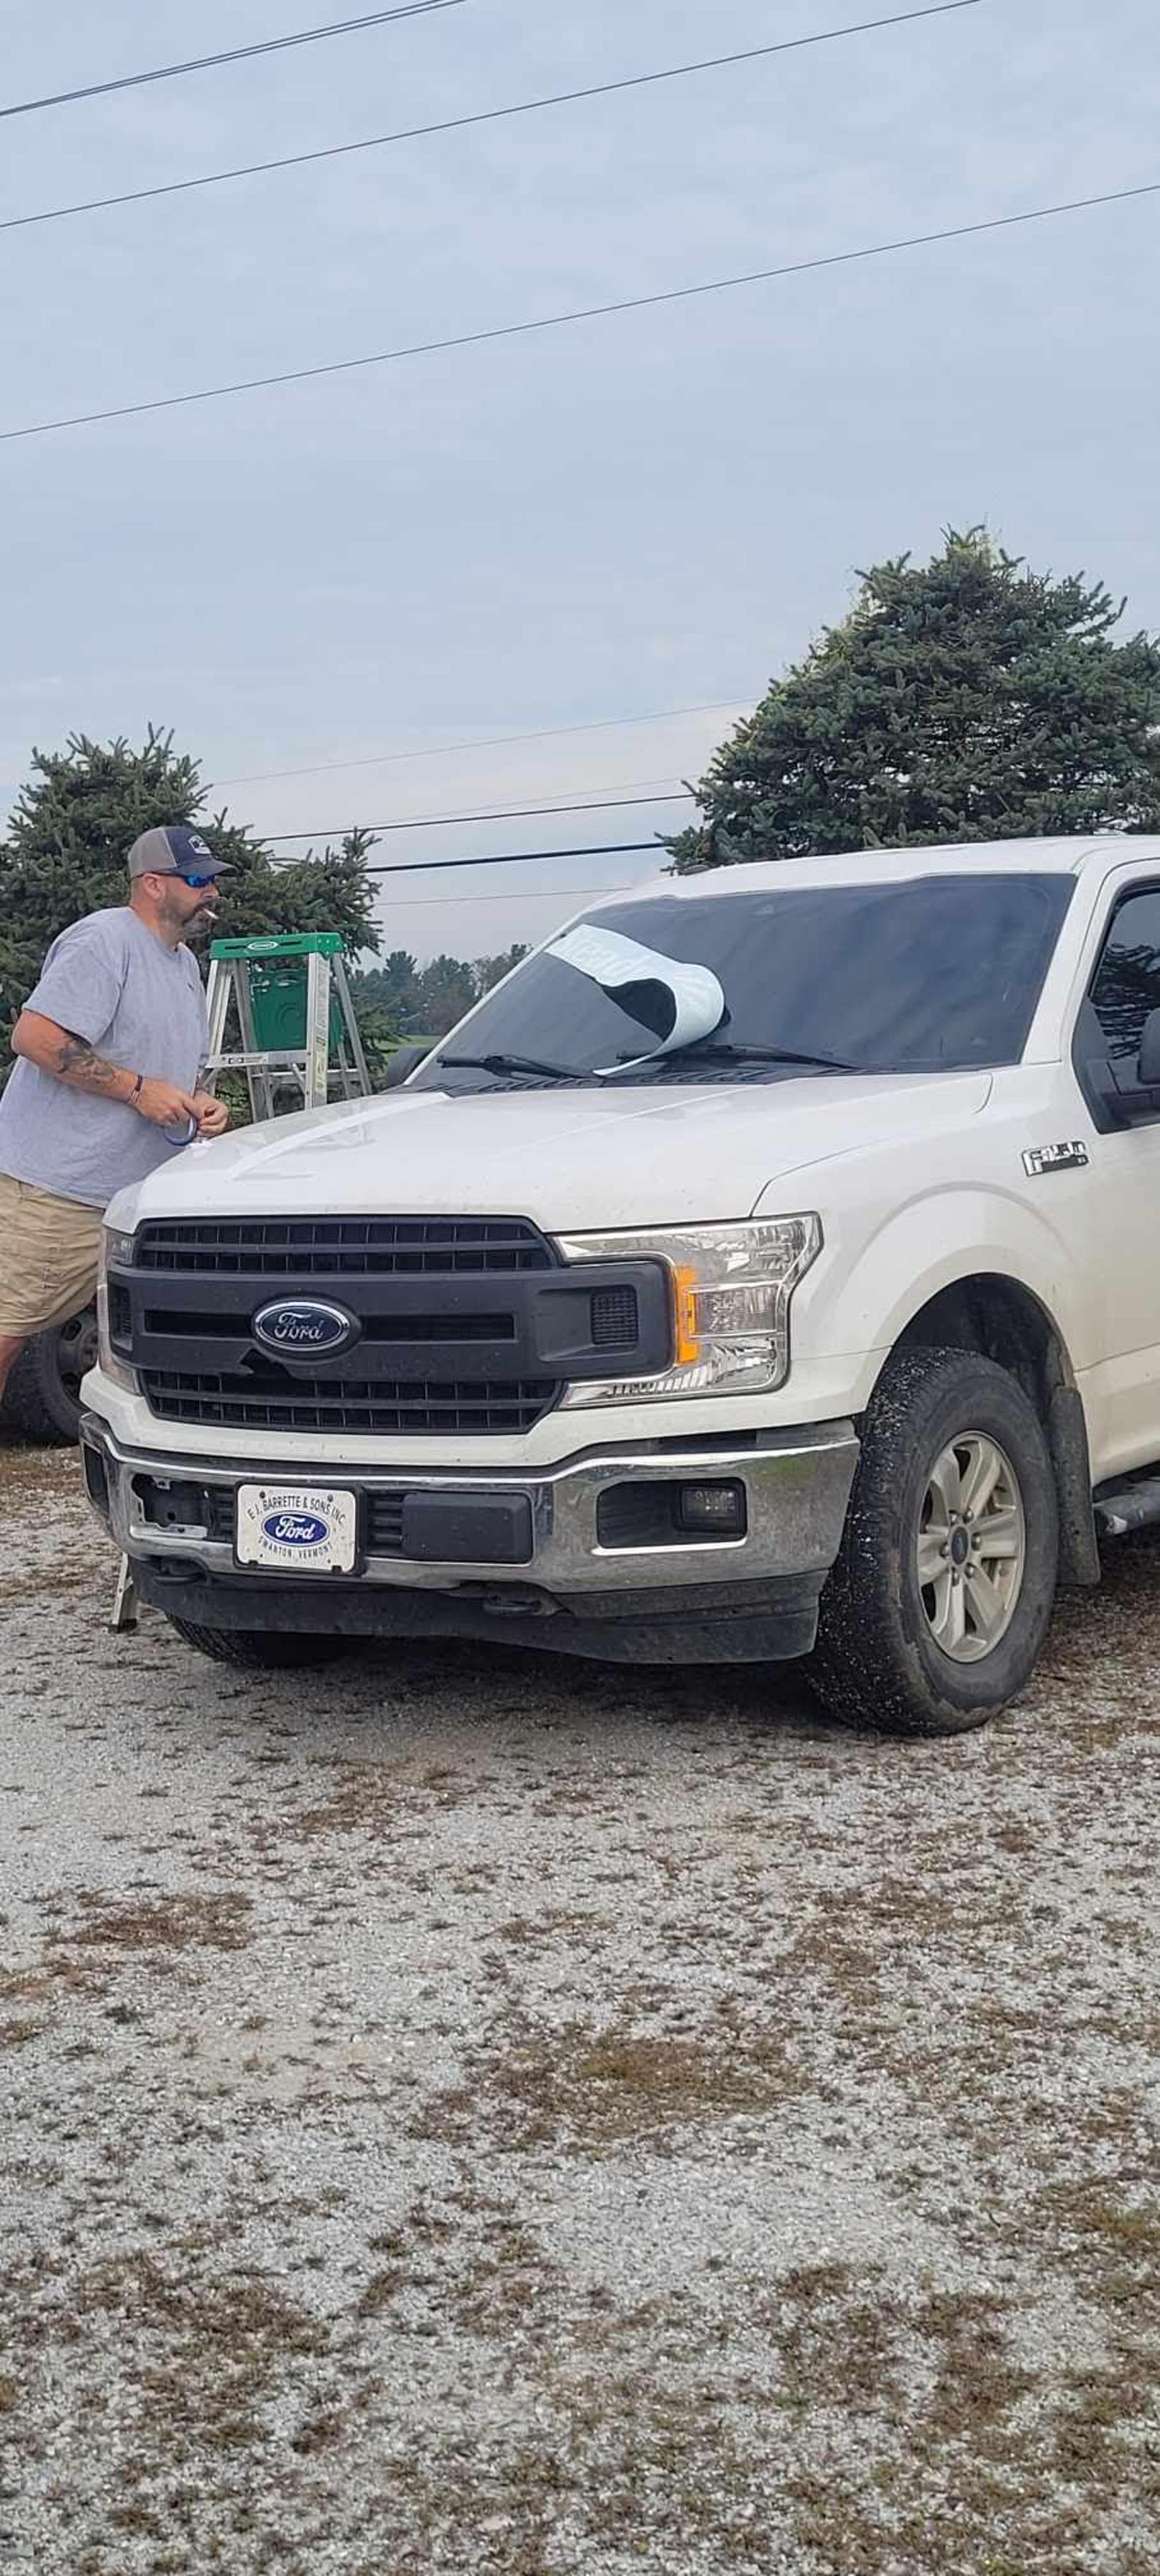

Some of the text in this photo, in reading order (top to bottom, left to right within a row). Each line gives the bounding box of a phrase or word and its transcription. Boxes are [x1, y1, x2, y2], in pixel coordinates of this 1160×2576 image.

[274, 1312, 324, 1339] Ford
[262, 1495, 301, 1512] BARRETTE
[303, 1496, 308, 1509] &
[310, 1498, 331, 1514] SONS
[275, 1516, 316, 1539] Ford
[298, 1541, 332, 1559] VERMONT
